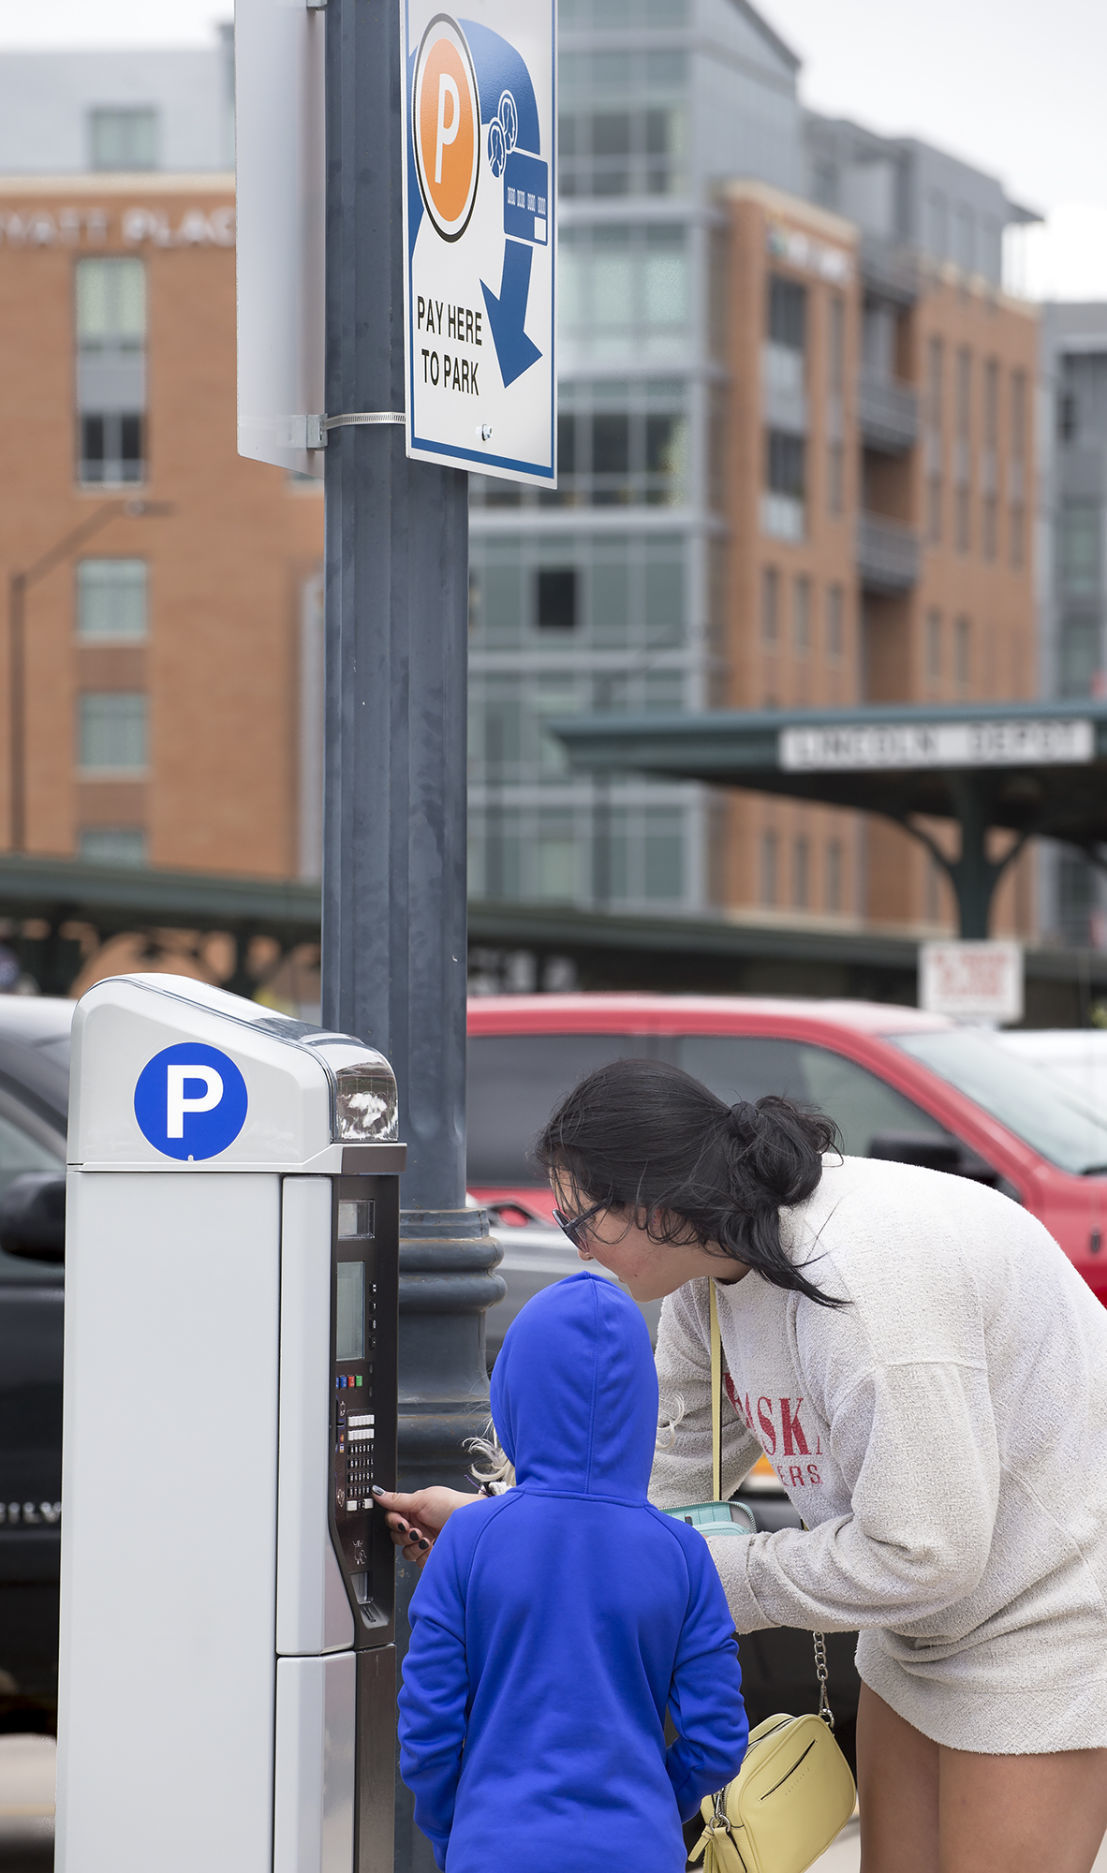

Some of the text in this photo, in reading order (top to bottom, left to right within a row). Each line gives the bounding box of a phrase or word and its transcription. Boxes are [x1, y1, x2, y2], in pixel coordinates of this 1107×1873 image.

[433, 72, 462, 185] P
[0, 206, 108, 247] YATT
[417, 295, 483, 346] PAY HERE
[421, 348, 480, 396] TO PARK
[166, 1064, 224, 1139] P
[0, 1501, 62, 1523] ILV
